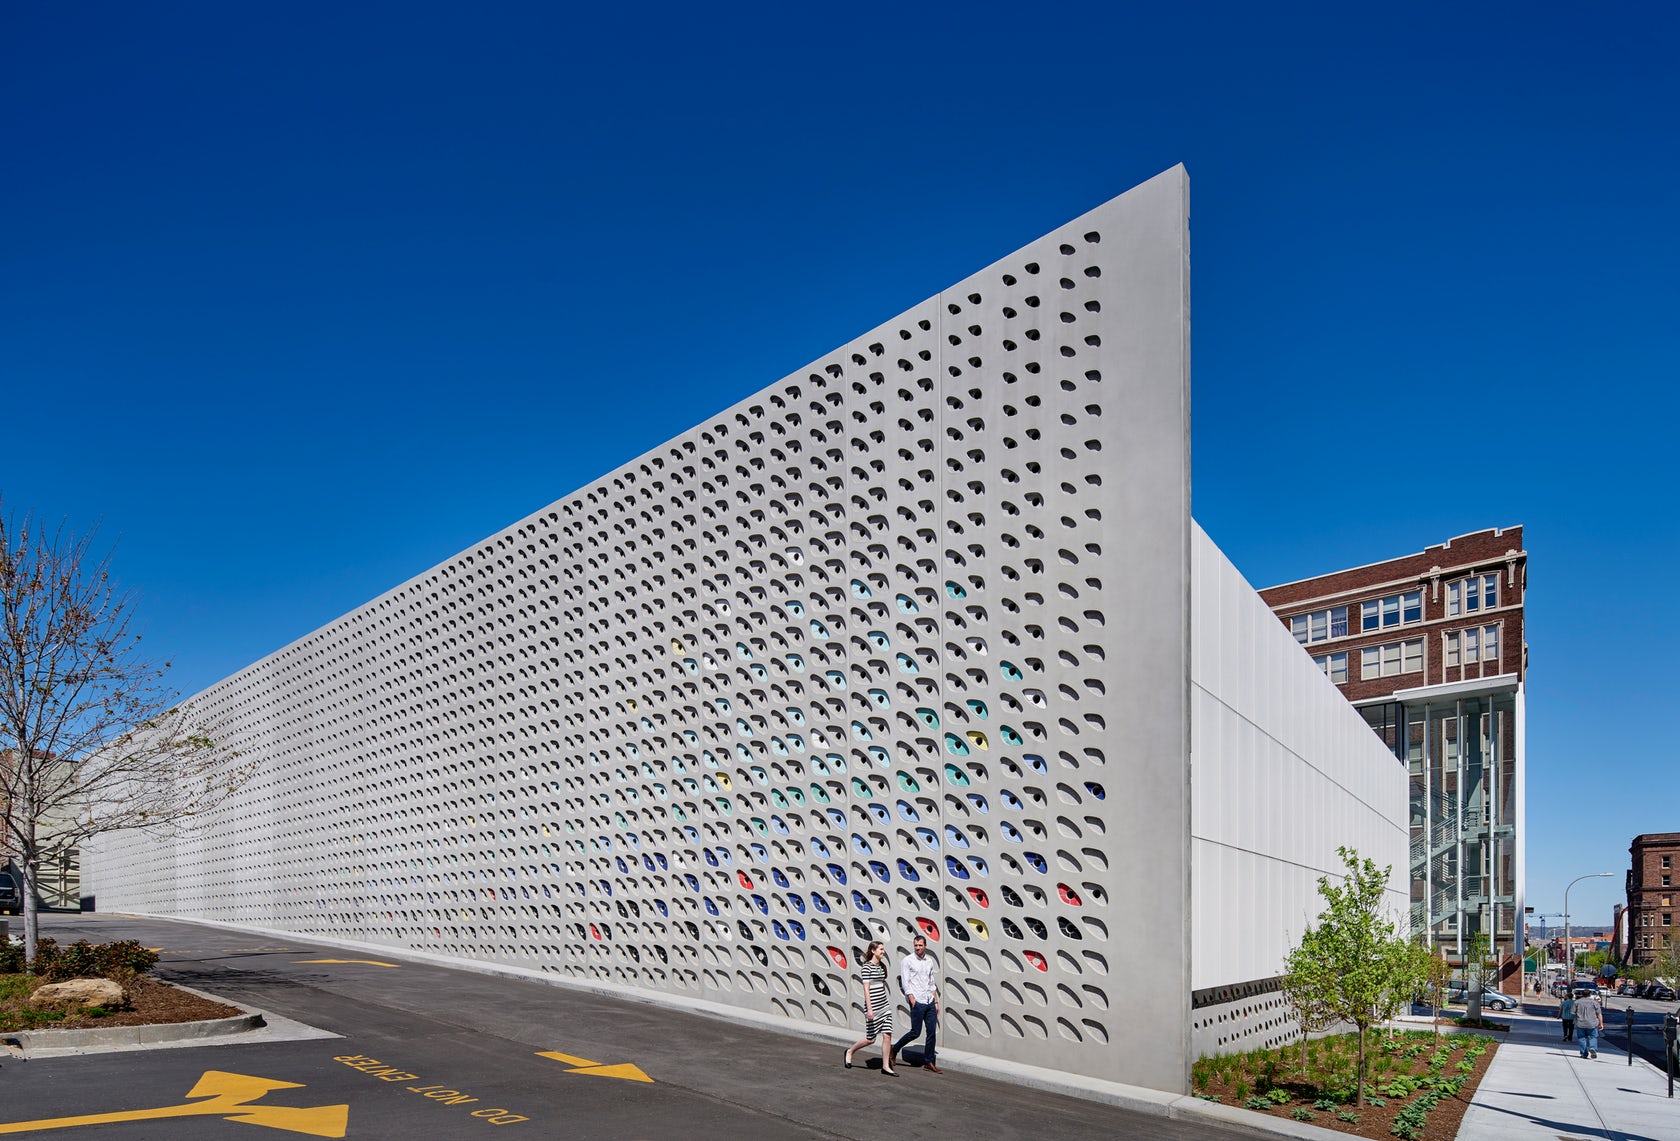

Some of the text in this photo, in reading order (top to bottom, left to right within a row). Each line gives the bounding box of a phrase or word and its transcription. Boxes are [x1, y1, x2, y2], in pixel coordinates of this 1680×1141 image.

[333, 1055, 530, 1125] DO NOT ENTER
